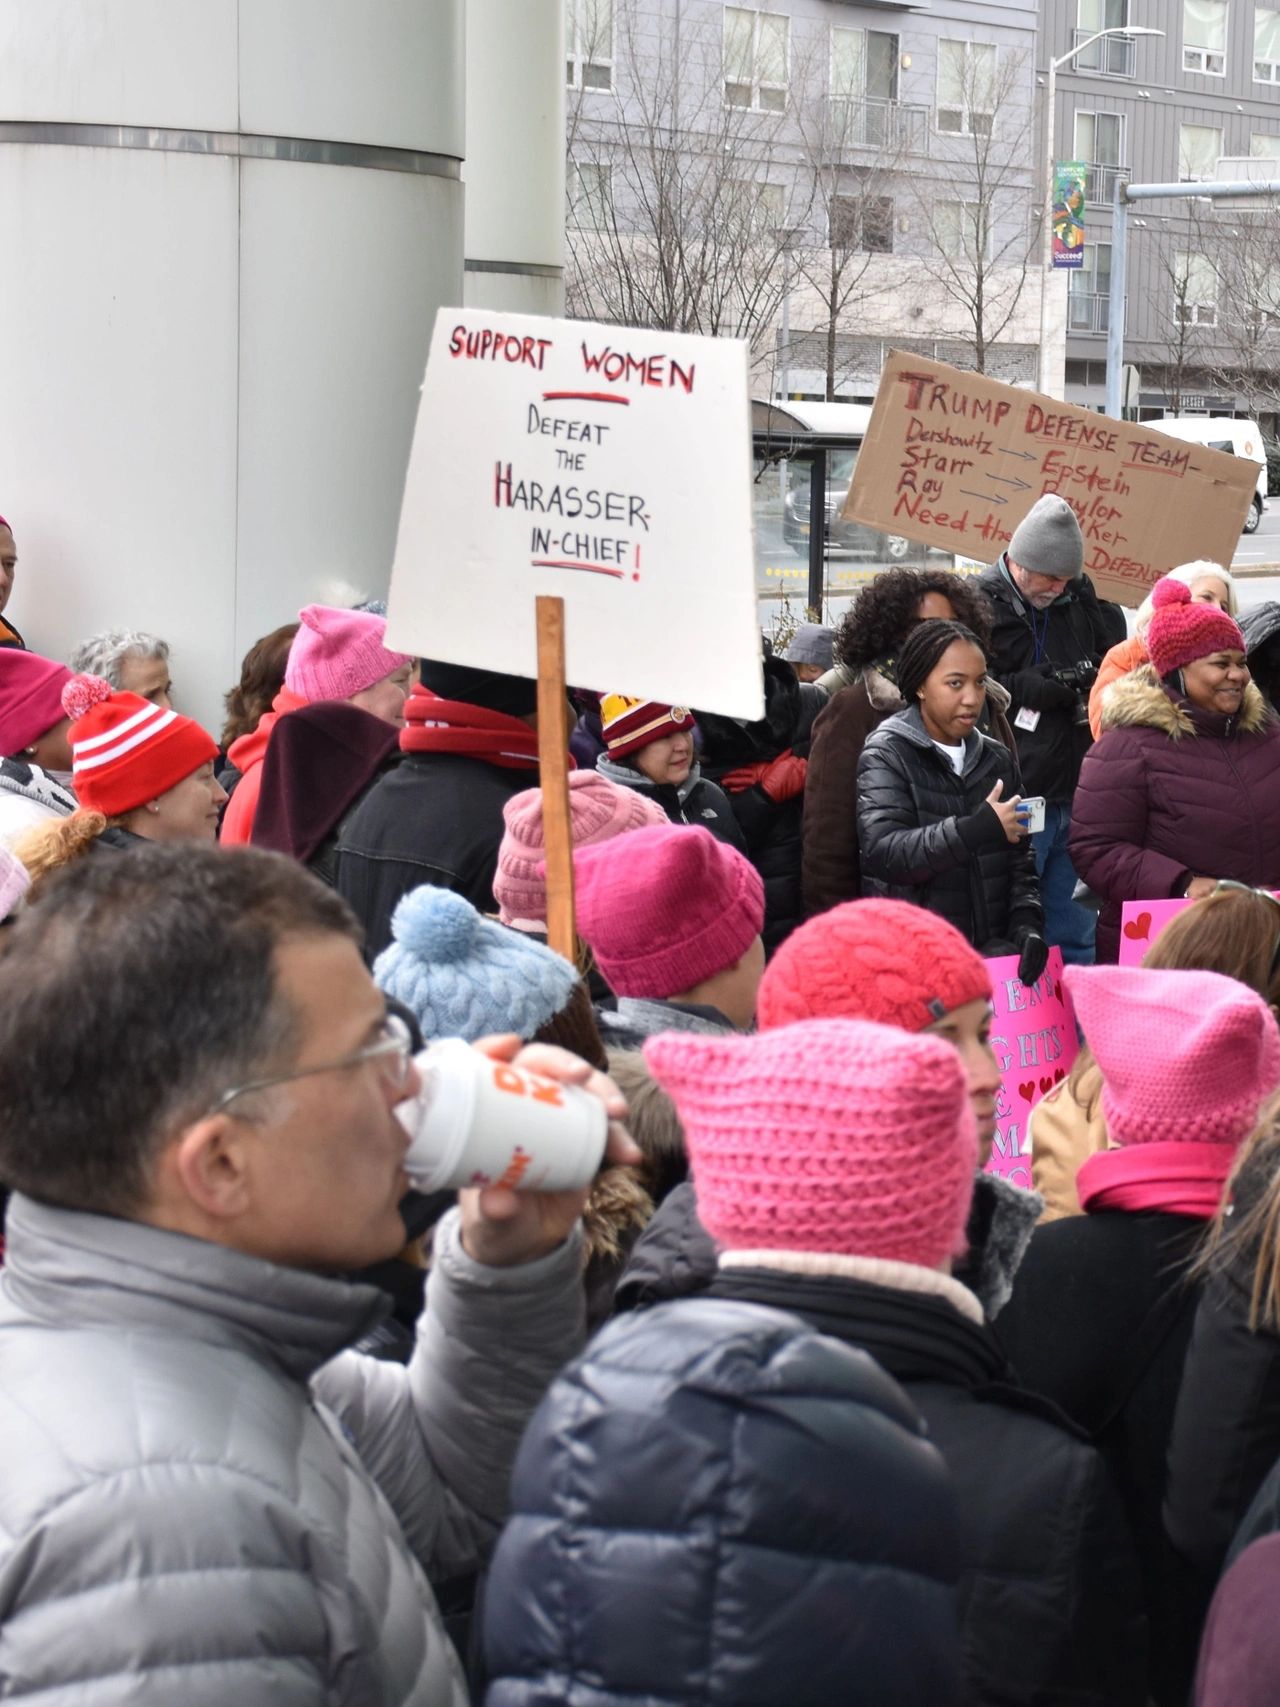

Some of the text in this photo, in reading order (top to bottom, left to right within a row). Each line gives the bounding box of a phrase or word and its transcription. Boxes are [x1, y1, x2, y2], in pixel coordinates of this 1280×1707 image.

[449, 325, 695, 393] SUPPORT WOMEN
[528, 404, 609, 445] DEFEAT
[898, 371, 1011, 426] TRUMP
[1025, 404, 1119, 453] DEFENSE
[905, 416, 994, 455] Dershowitz
[556, 450, 586, 471] THE
[900, 445, 974, 474] Starr
[896, 469, 943, 502] Ray
[894, 492, 968, 533] Need
